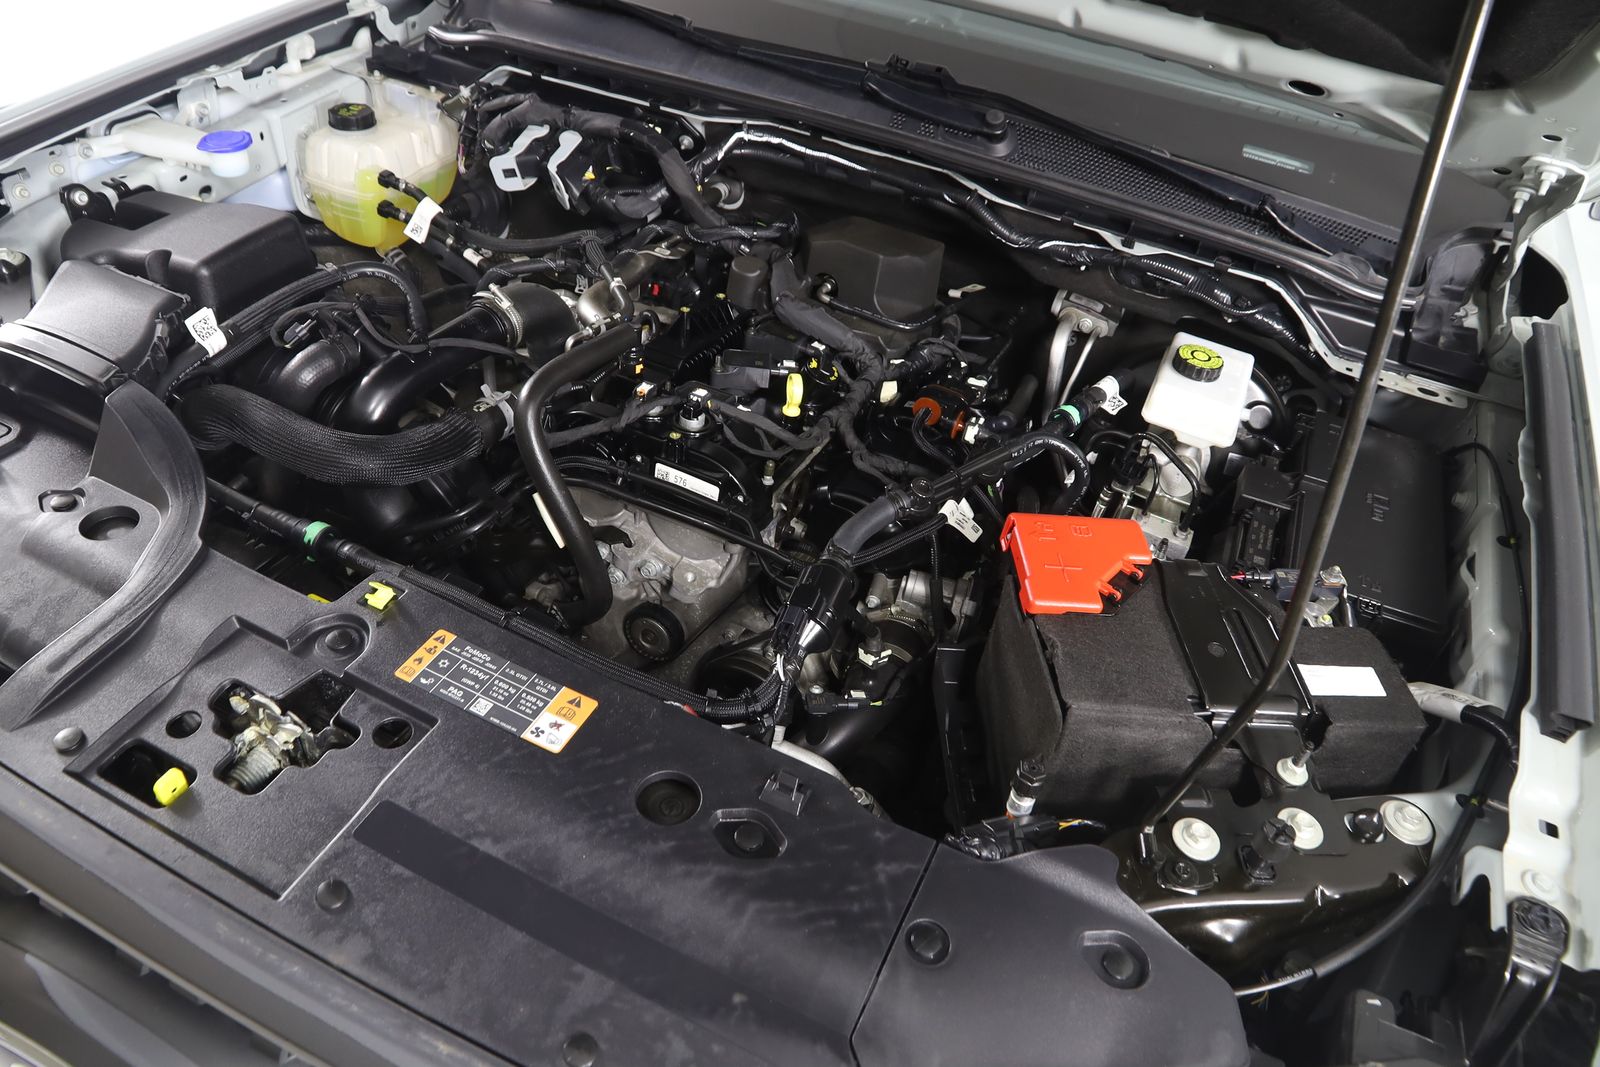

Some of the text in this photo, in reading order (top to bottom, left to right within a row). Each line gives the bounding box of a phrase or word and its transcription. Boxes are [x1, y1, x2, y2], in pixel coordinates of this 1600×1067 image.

[673, 475, 687, 487] 576
[464, 645, 491, 661] FoMoCo
[460, 663, 490, 680] R-1234yf
[447, 686, 464, 697] PAG
[508, 685, 517, 694] kg
[536, 699, 545, 707] kg
